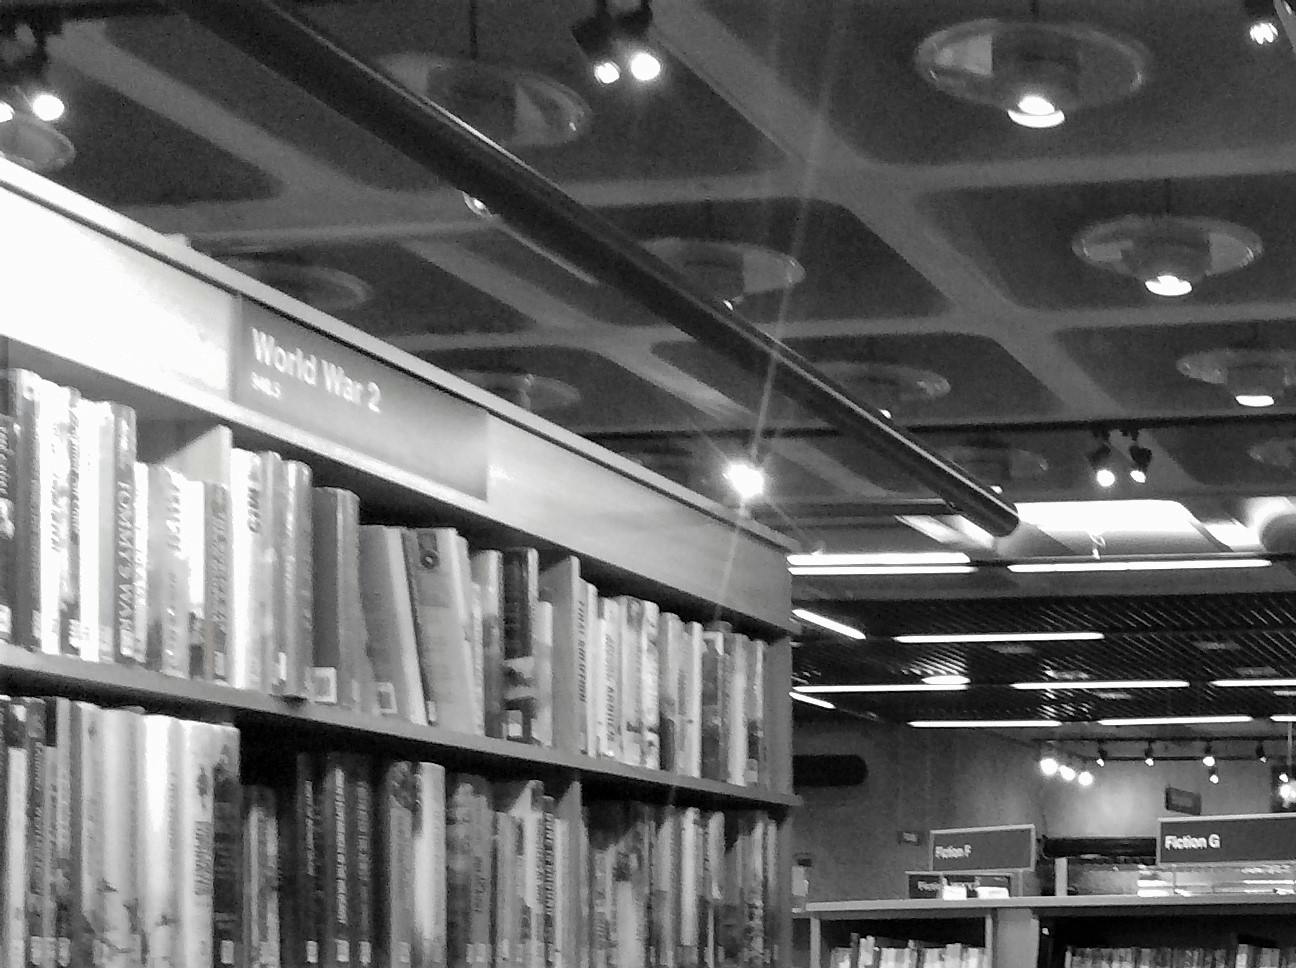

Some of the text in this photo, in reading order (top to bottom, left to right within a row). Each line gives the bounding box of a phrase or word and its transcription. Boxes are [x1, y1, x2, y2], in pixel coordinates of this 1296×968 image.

[252, 327, 381, 413] World War 2
[1164, 833, 1220, 850] Fiction G
[934, 845, 964, 859] Fiction
